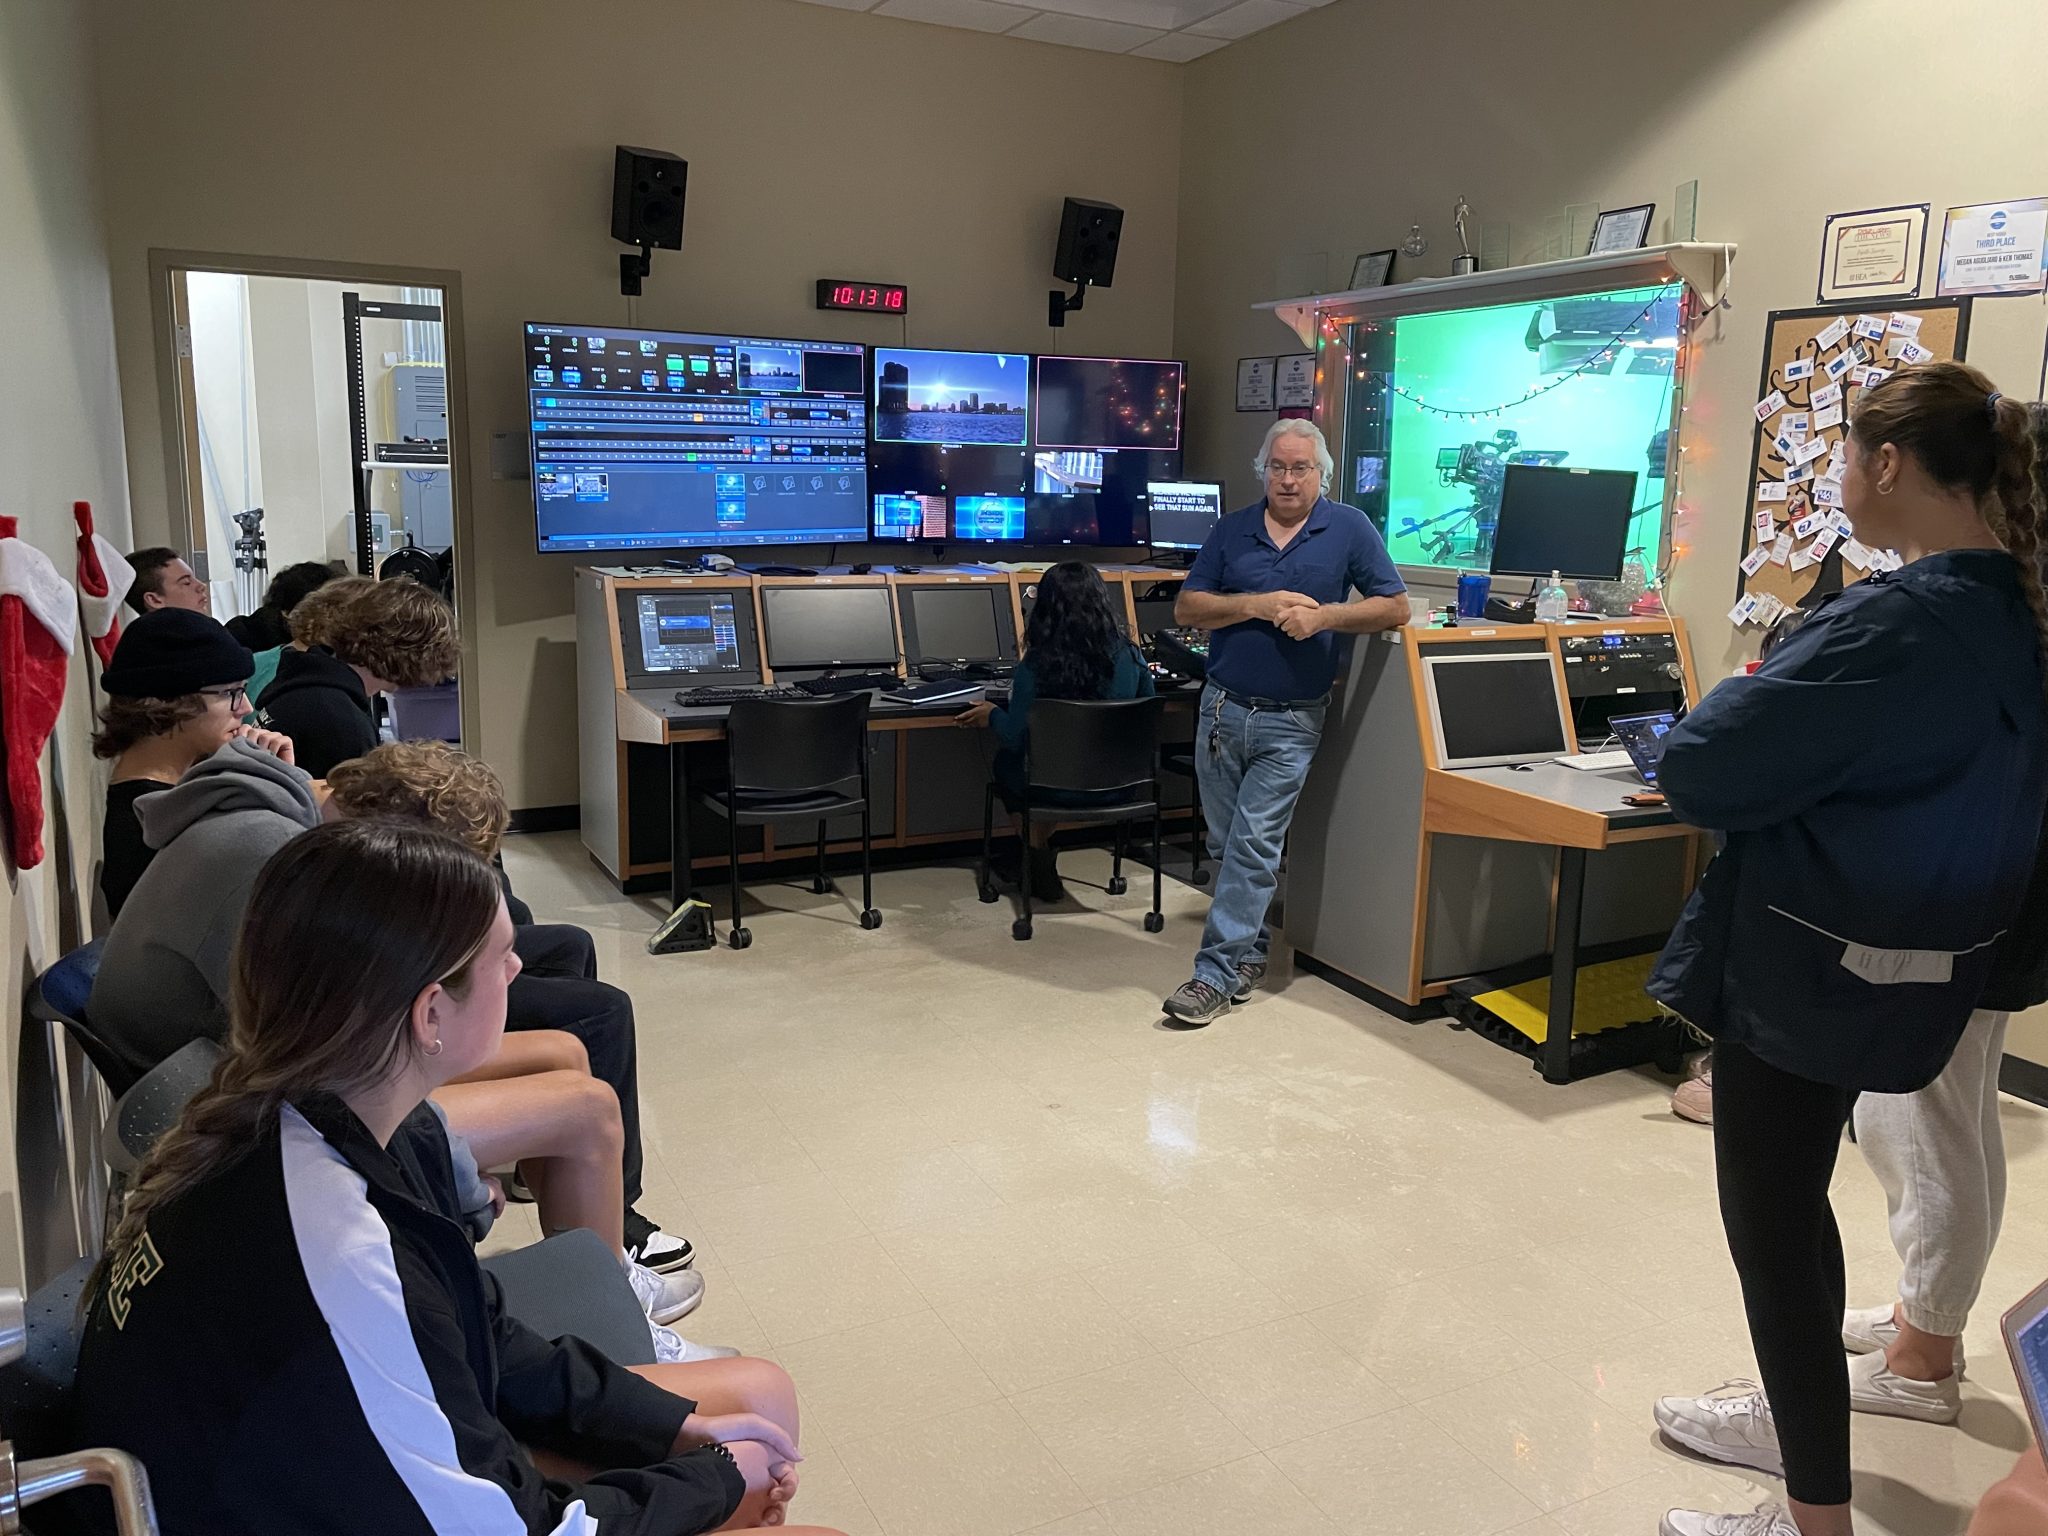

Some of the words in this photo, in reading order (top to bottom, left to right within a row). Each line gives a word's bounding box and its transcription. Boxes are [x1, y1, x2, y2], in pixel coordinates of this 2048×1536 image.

[1976, 238, 1995, 248] THIRD
[1996, 236, 2016, 247] PLACE
[2014, 252, 2033, 260] THOMAS
[1153, 495, 1177, 503] FINALLY
[1178, 496, 1196, 504] START
[1154, 503, 1166, 511] SEE
